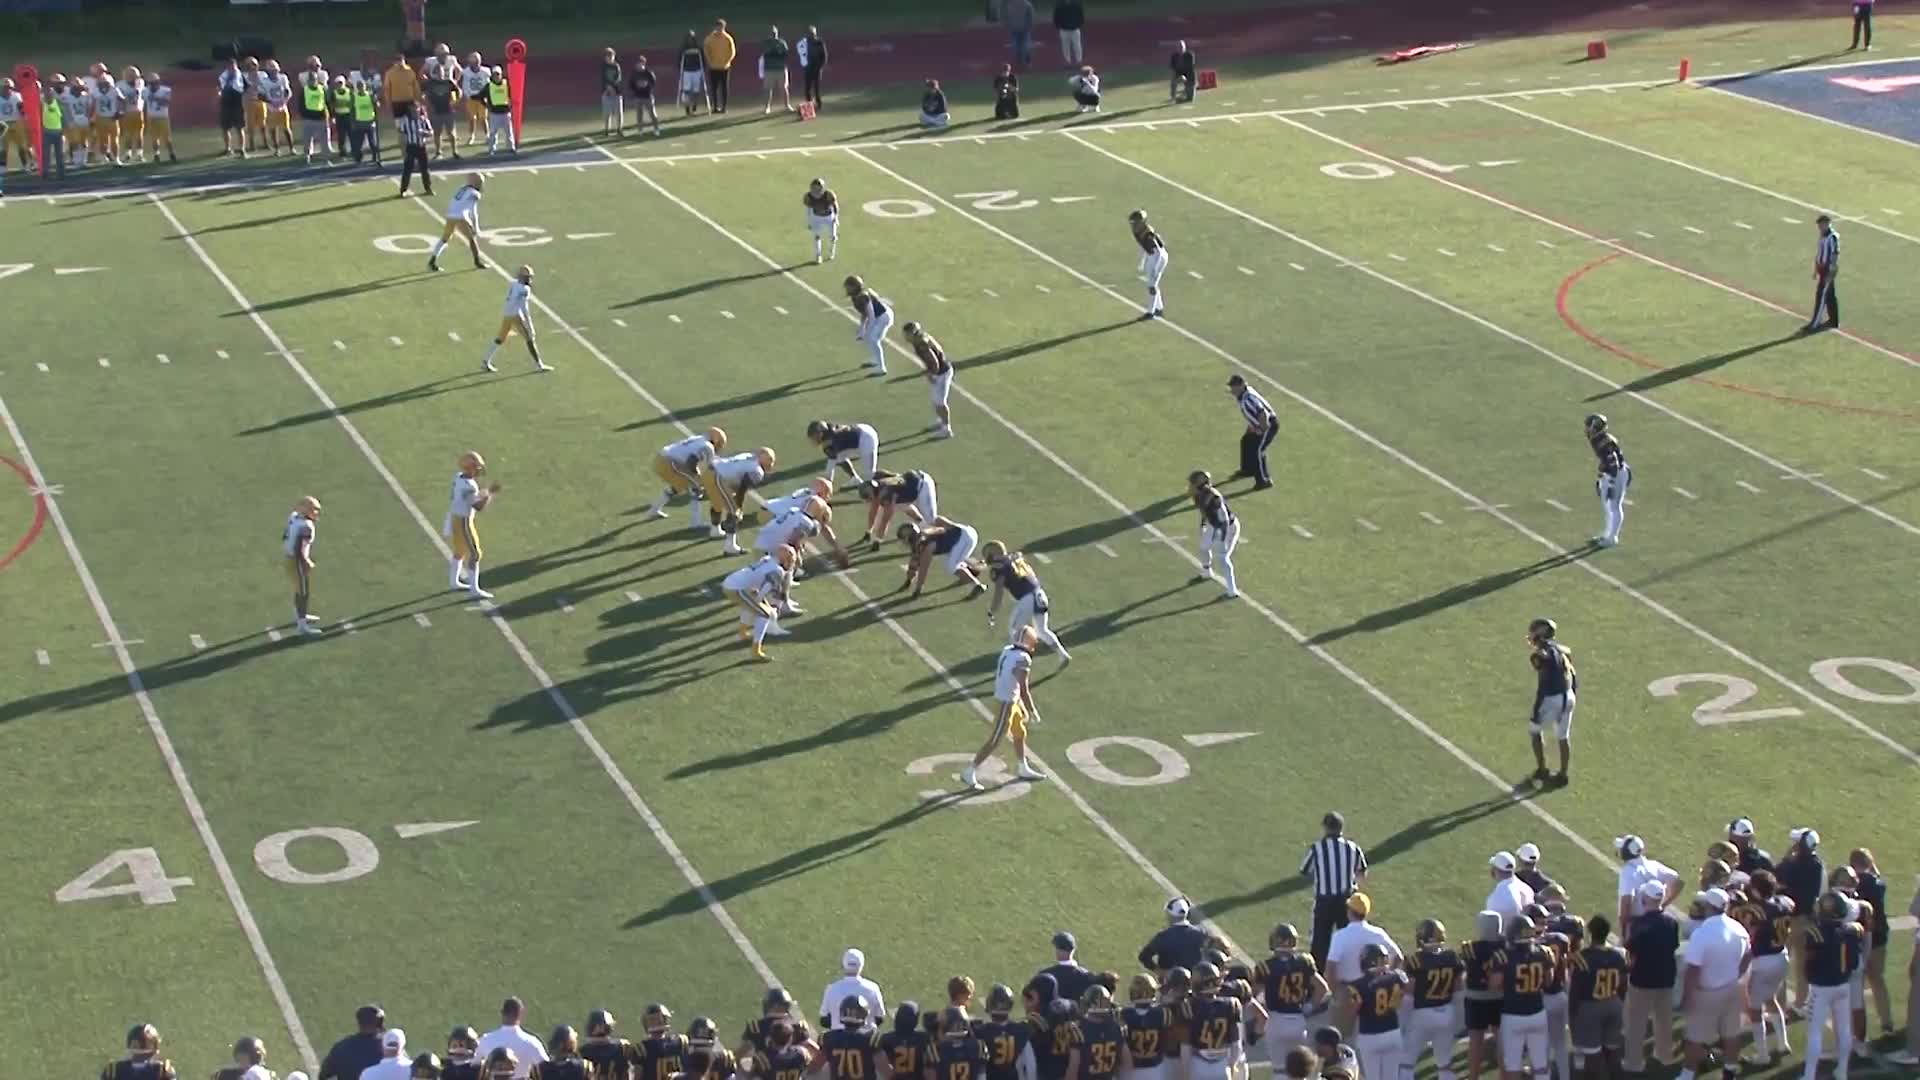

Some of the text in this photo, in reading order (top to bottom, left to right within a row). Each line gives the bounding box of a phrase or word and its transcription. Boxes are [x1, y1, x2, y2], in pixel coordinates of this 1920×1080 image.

[863, 190, 1039, 219] 20
[1647, 657, 1920, 727] 20
[904, 735, 1191, 806] 30
[55, 826, 380, 905] 40
[1515, 962, 1543, 993] 50
[1592, 967, 1620, 1000] 60
[832, 1048, 864, 1080] 70
[994, 1035, 1015, 1065] 31
[1088, 1041, 1118, 1074] 35
